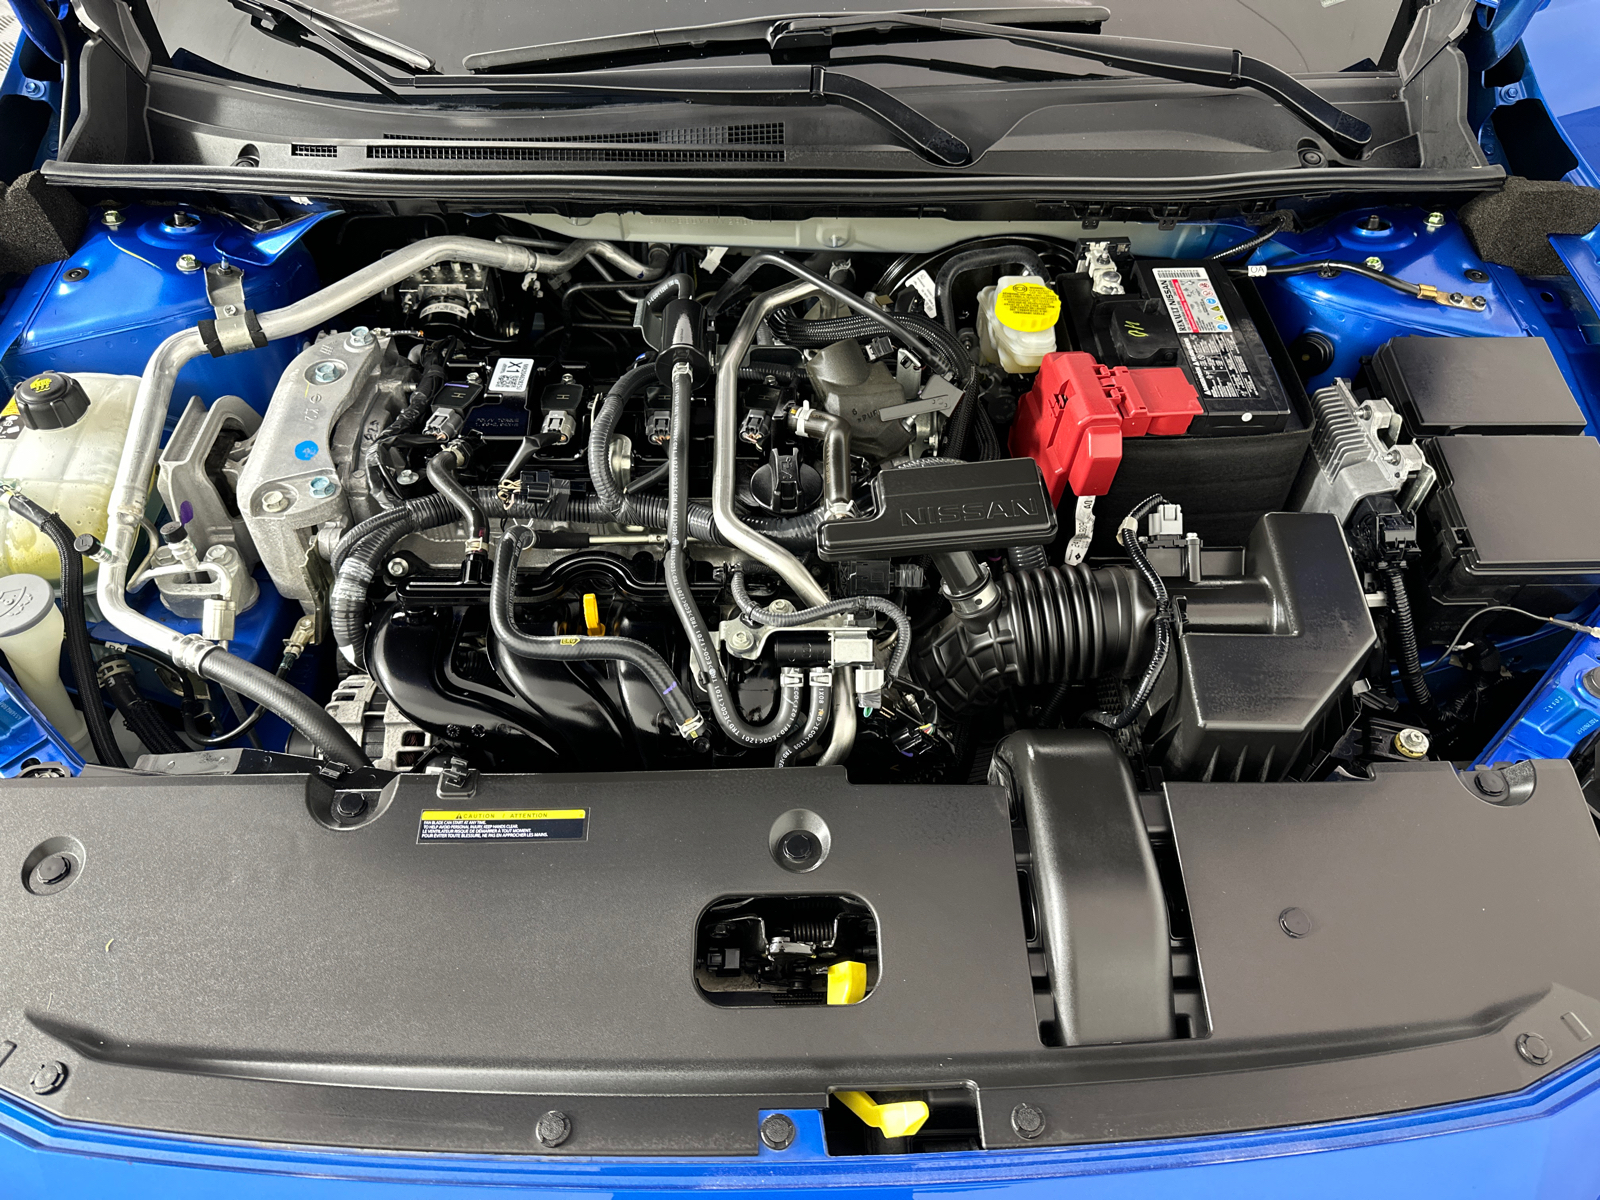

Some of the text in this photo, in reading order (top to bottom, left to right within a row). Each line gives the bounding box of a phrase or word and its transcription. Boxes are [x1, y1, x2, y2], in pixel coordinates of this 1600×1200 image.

[1160, 280, 1177, 307] NISSAN
[1171, 306, 1187, 332] RENAULT
[506, 361, 523, 373] X1
[900, 497, 1039, 527] NISSAN
